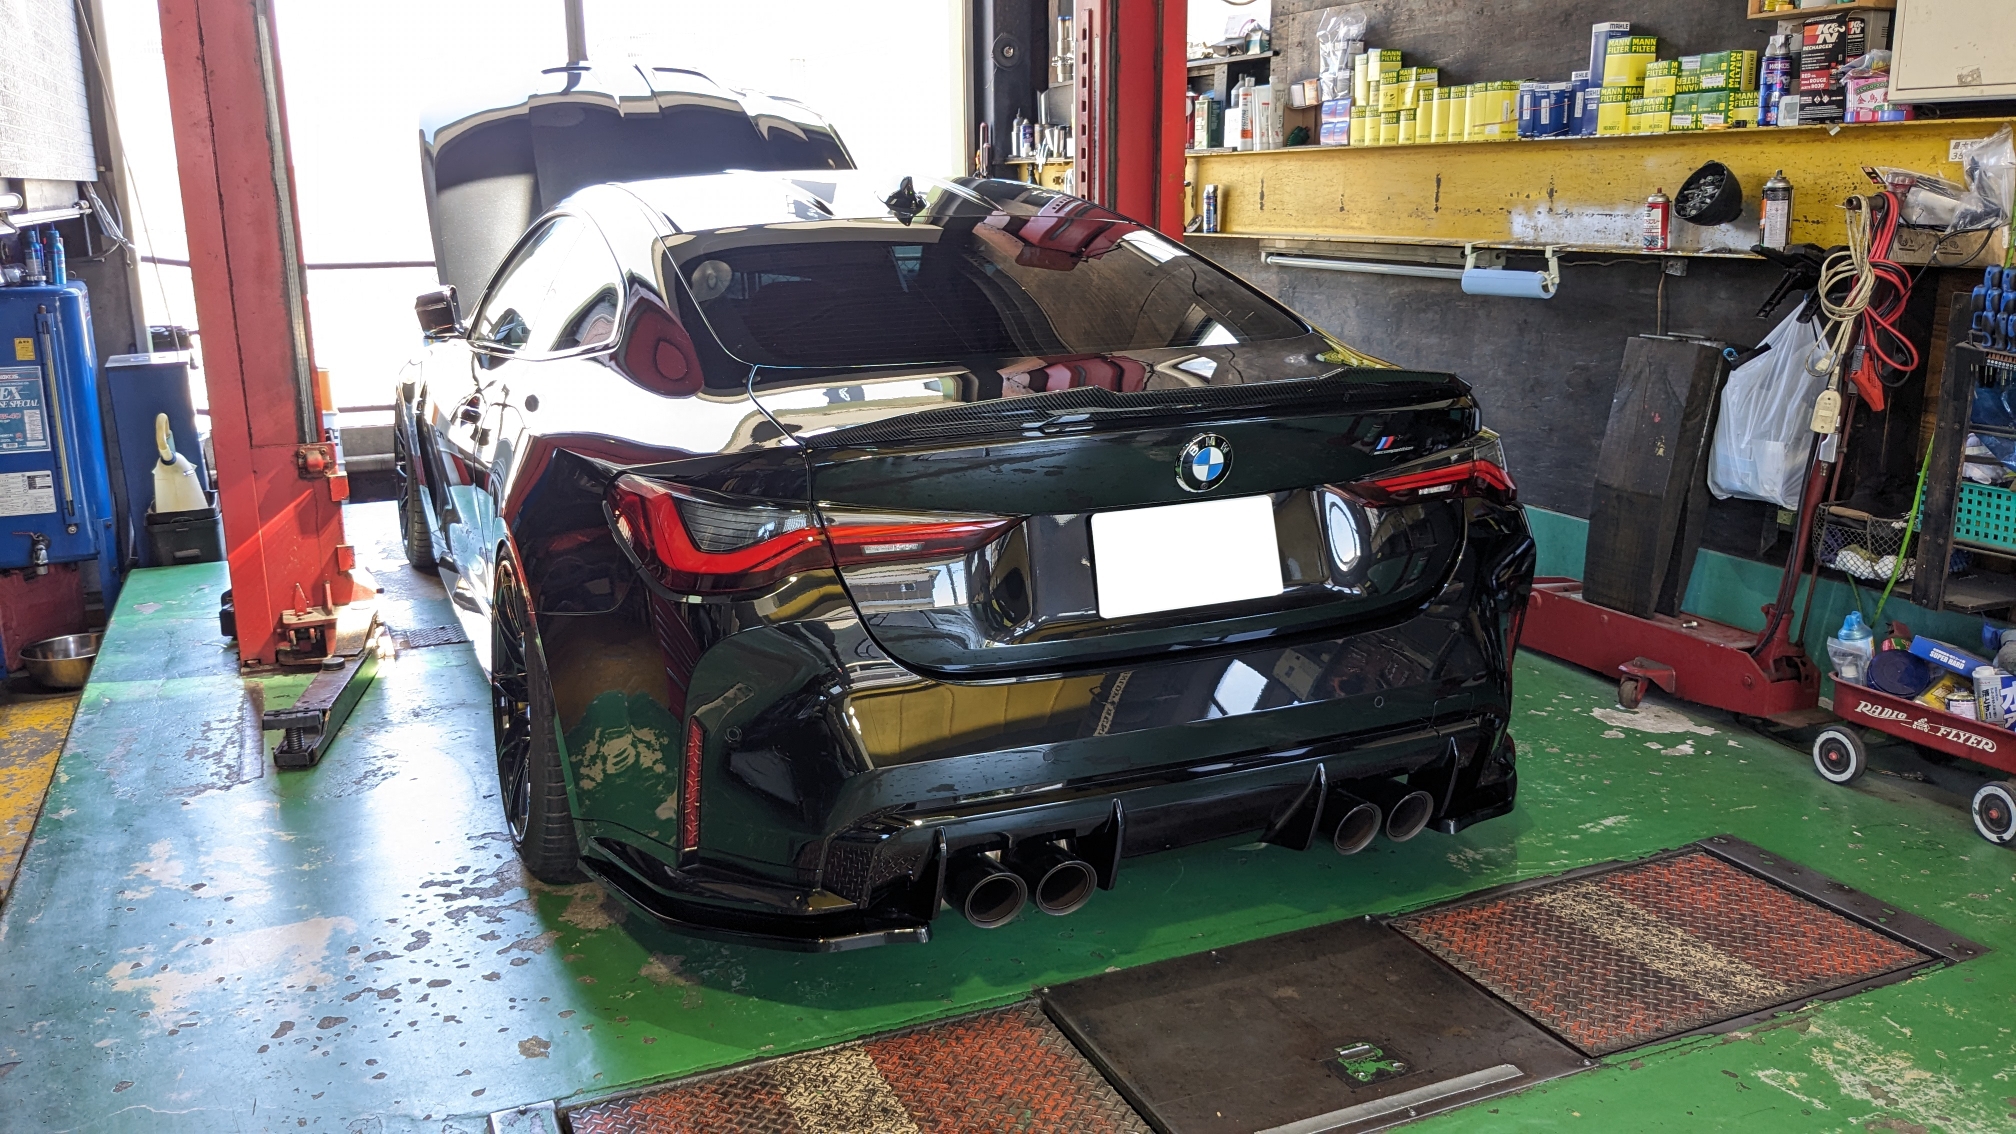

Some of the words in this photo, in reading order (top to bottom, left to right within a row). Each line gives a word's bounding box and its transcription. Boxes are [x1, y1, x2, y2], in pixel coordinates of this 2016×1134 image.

[1608, 38, 1630, 47] MANN
[1632, 38, 1657, 46] MANN
[1631, 45, 1656, 53] FILTER
[1646, 61, 1669, 69] MANN
[1646, 69, 1668, 77] FILTER
[1728, 52, 1737, 88] MANN
[1733, 52, 1743, 88] FILTER
[1600, 87, 1623, 95] MANN
[1600, 94, 1623, 102] FILTER
[1643, 97, 1665, 105] MANN
[1734, 99, 1759, 107] FILTER
[1643, 104, 1664, 112] FILTER
[9, 399, 40, 408] SPECIAL
[1188, 436, 1231, 457] BMW
[1929, 650, 1949, 663] SUPER
[1947, 658, 1965, 670] HARD
[1854, 700, 1908, 720] RADIO
[1935, 725, 1997, 753] FLYER
